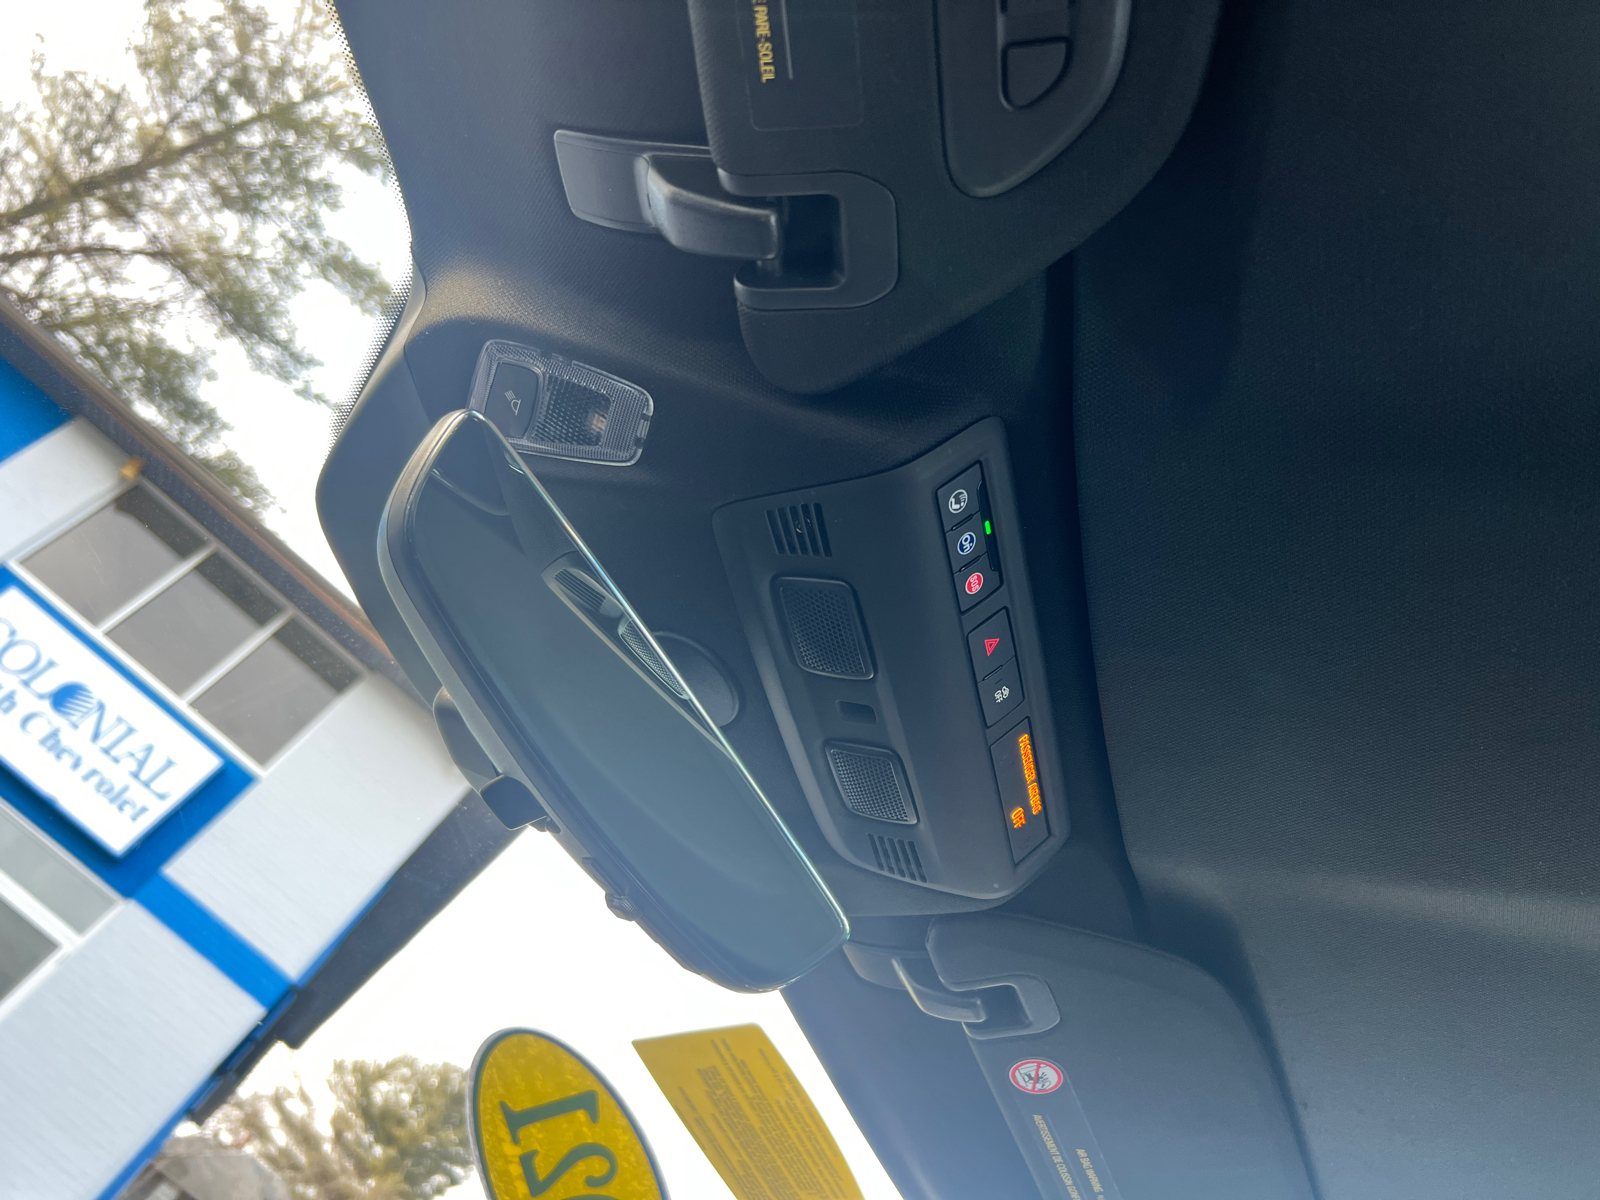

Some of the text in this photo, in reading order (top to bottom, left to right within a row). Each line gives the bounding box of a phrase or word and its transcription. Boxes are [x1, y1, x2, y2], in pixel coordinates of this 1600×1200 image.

[753, 5, 776, 83] PARE-SOLEIL
[969, 575, 980, 592] SOS
[994, 690, 1004, 703] OFF
[1018, 733, 1037, 785] PASSENGER
[1010, 807, 1026, 829] OFF
[1032, 1114, 1060, 1155] AVERTISSEMENT
[1052, 1155, 1064, 1163] DE
[1075, 1148, 1088, 1158] AIR
[1079, 1157, 1093, 1169] BAG
[1056, 1163, 1073, 1186] COUSSIN
[1085, 1168, 1104, 1193] WARNING
